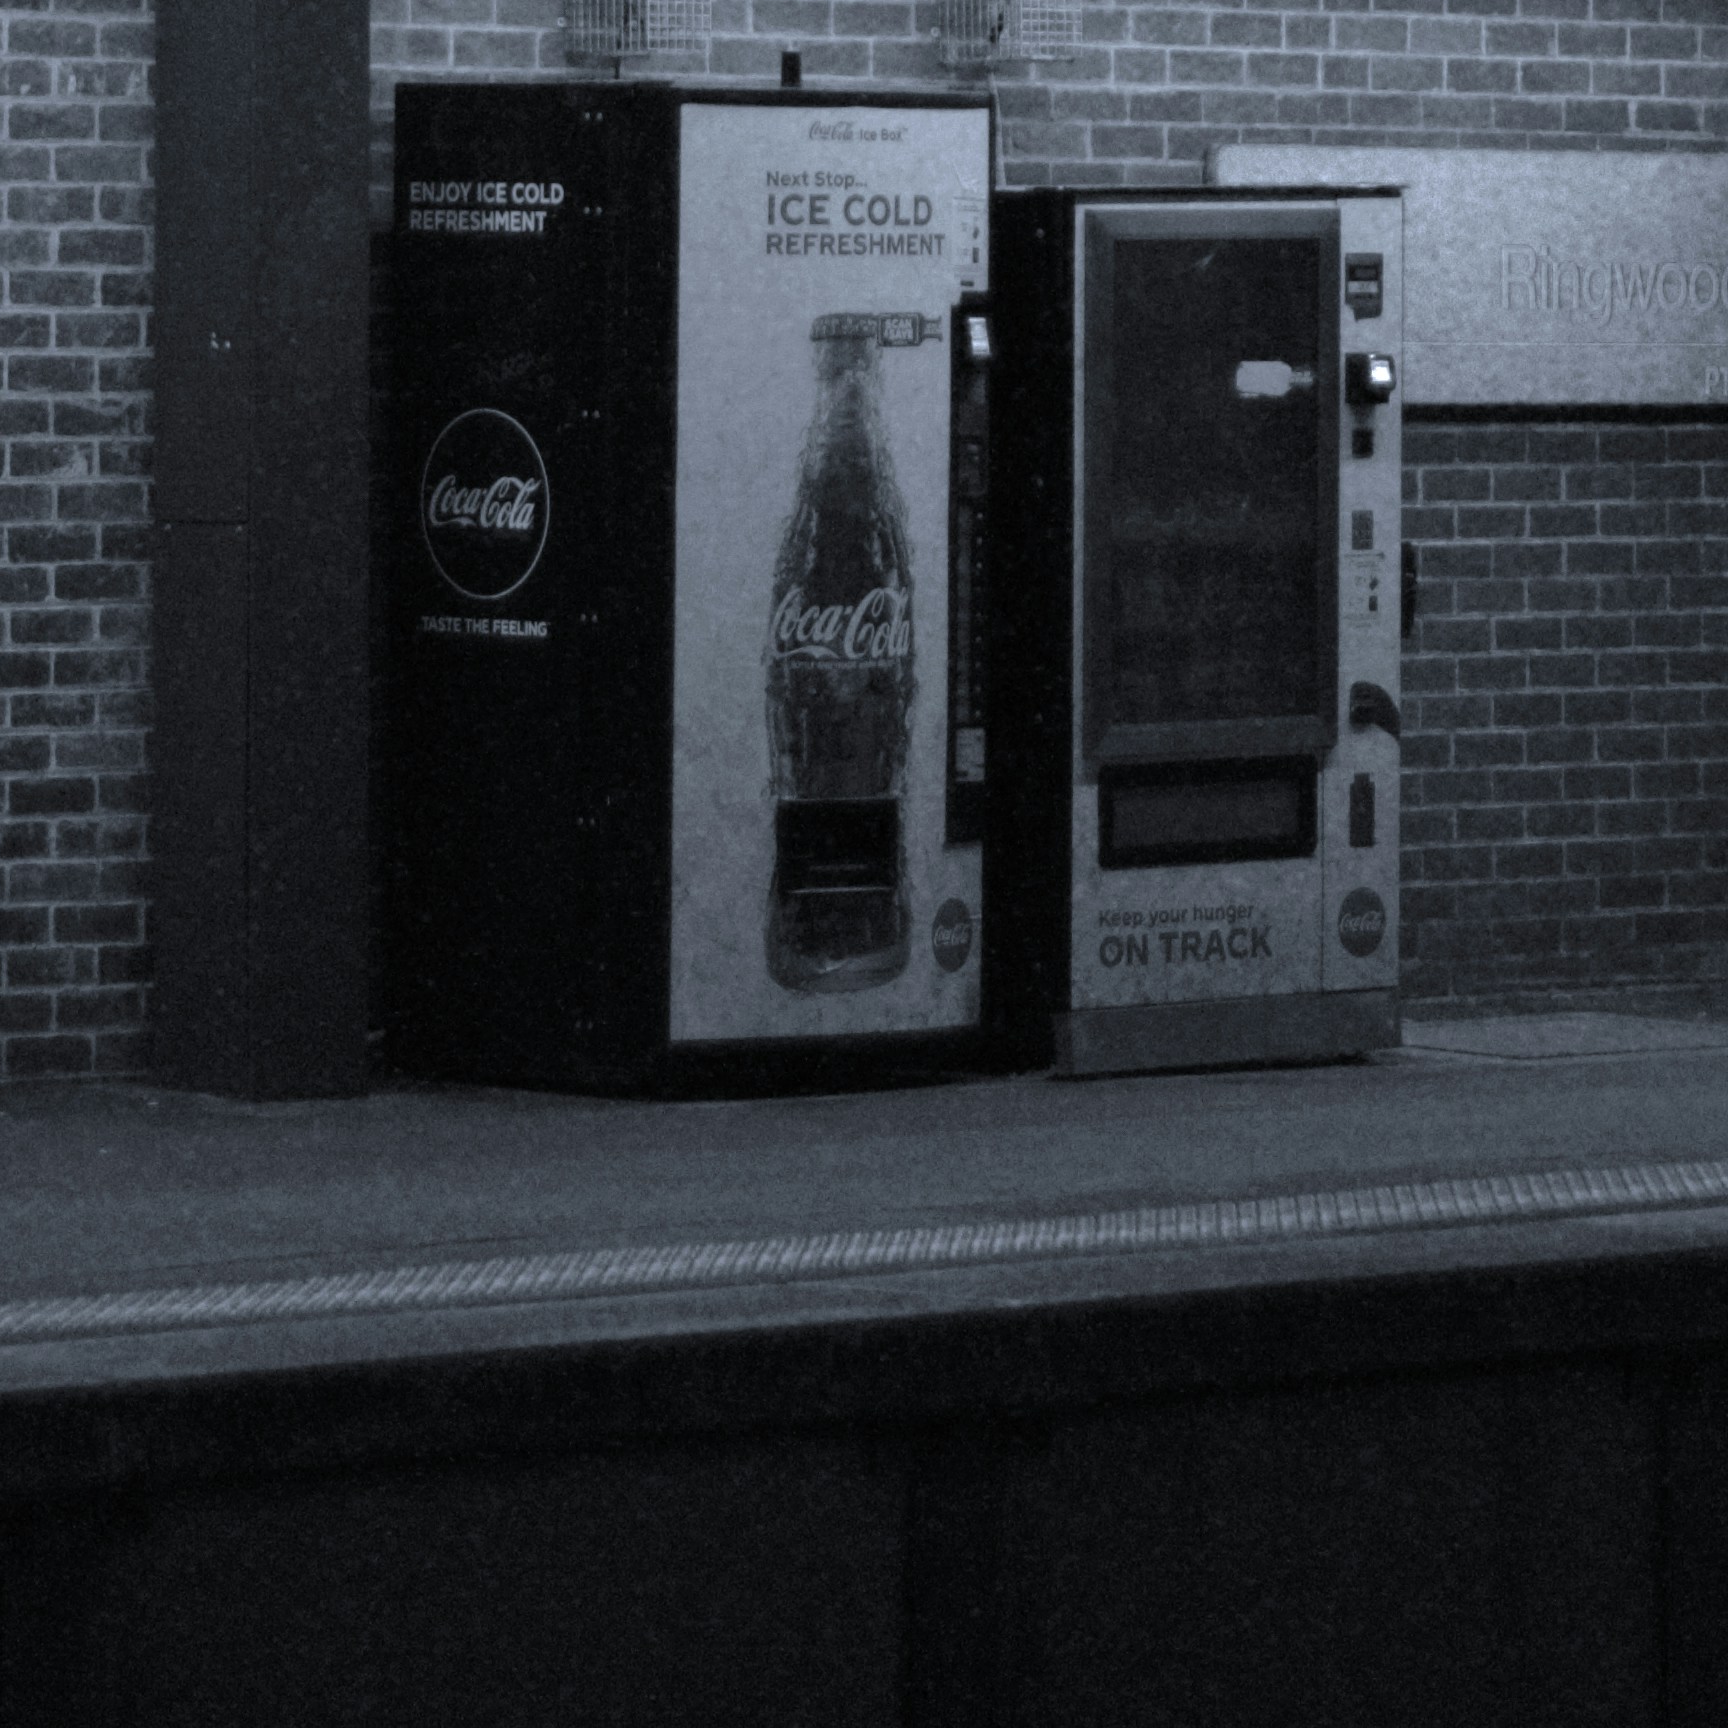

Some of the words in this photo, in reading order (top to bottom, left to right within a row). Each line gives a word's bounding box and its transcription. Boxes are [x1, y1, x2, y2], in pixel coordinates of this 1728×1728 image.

[409, 180, 472, 203] ENJOY
[476, 181, 508, 204] ICE
[510, 181, 565, 205] COLD
[765, 171, 808, 187] Next
[814, 171, 868, 190] Stop...
[410, 208, 547, 233] REFRESHMENT
[768, 193, 831, 226] ICE
[842, 194, 932, 226] COLD
[765, 232, 945, 256] REFRESHMENT
[428, 474, 542, 530] Coca-Cola
[421, 615, 462, 632] TASTE
[464, 617, 490, 635] THE
[492, 619, 549, 638] FEELING
[773, 584, 911, 660] Coca-Cola
[1099, 910, 1144, 928] Keep
[1149, 907, 1189, 927] your
[1192, 904, 1255, 924] hunger
[1099, 934, 1149, 968] ON
[1159, 925, 1272, 964] TRACK
